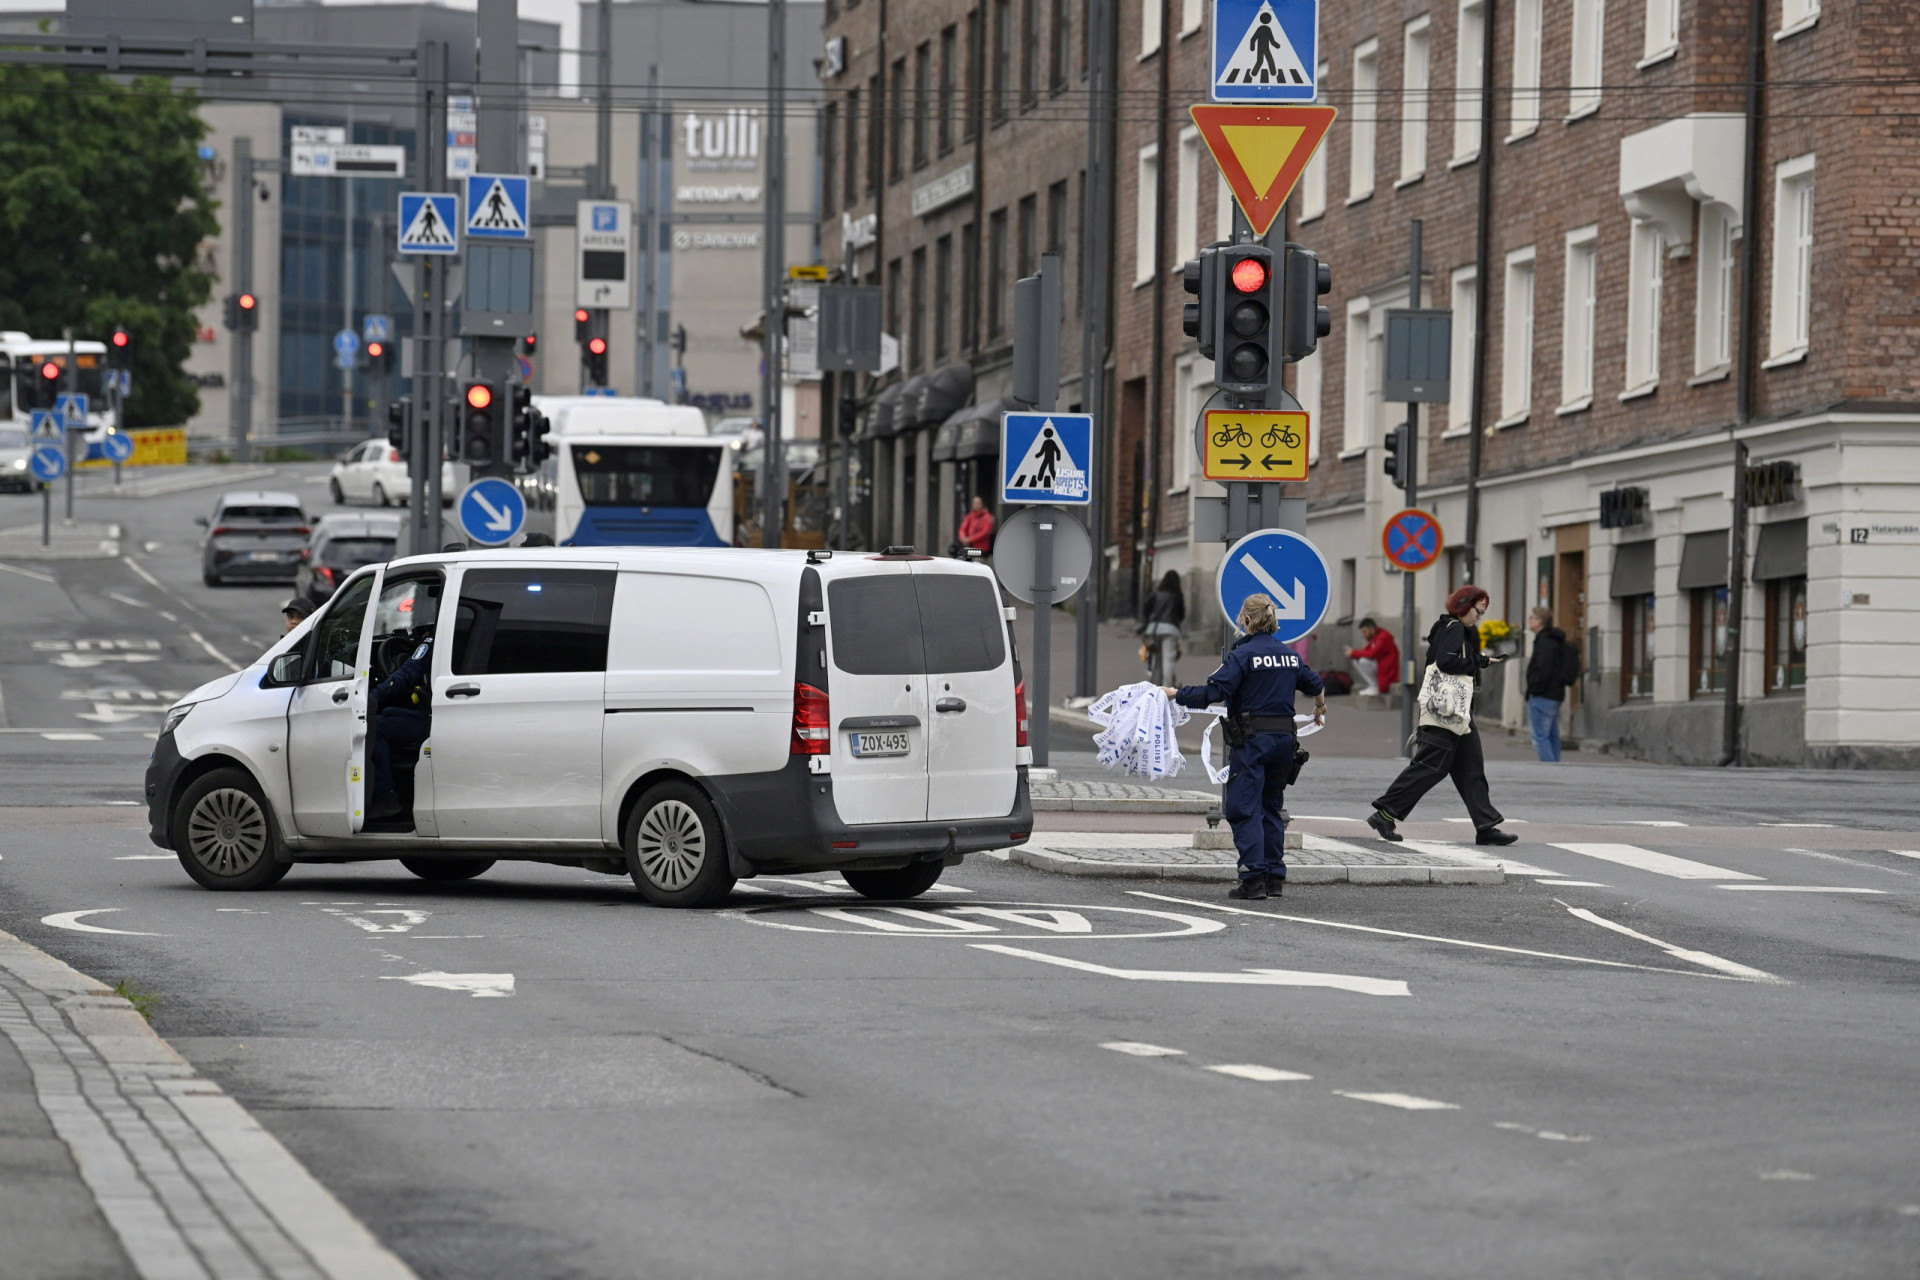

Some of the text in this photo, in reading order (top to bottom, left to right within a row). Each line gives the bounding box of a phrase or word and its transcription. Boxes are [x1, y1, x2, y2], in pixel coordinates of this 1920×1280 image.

[684, 109, 760, 157] tulli
[1853, 529, 1867, 543] 12
[1252, 655, 1300, 669] POLIISI
[860, 734, 908, 752] ZOX-493
